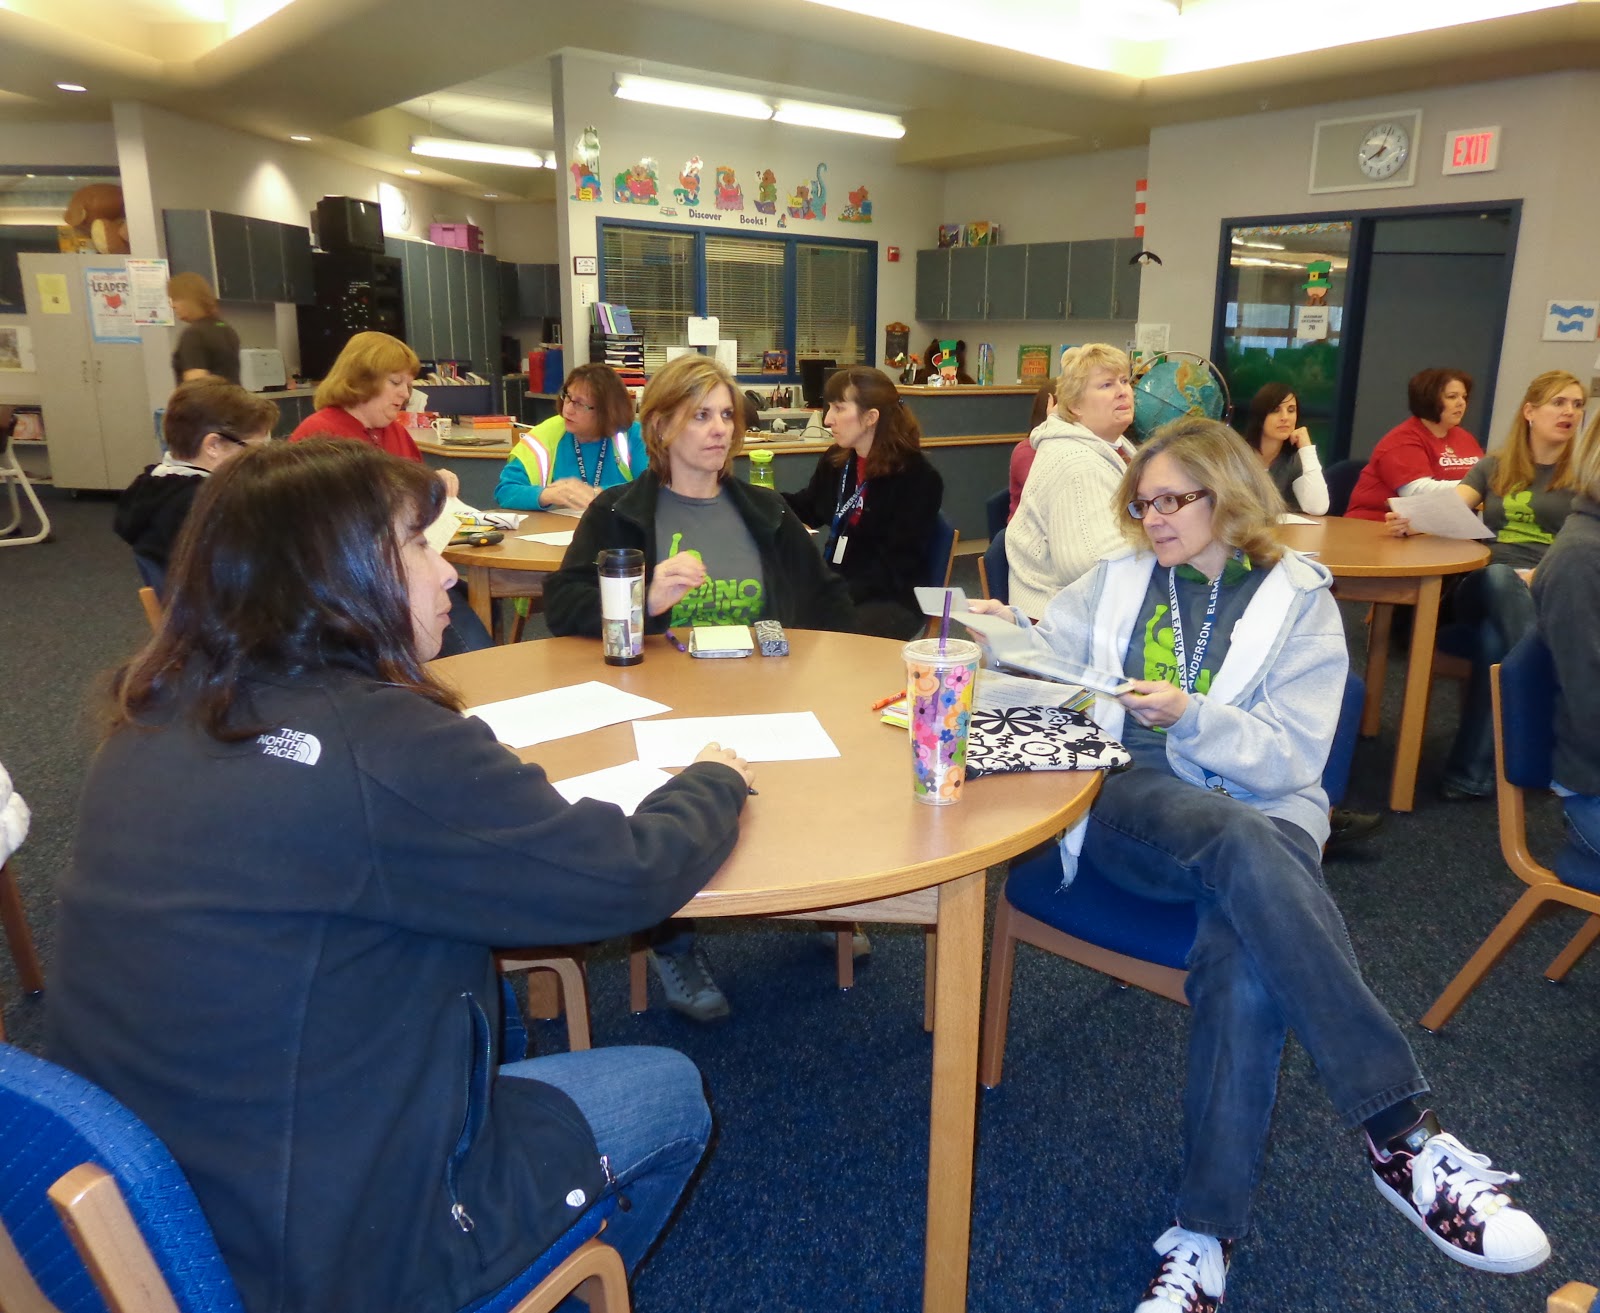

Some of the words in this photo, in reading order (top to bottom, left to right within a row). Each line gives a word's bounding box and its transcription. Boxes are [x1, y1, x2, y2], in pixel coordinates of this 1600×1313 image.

[1452, 132, 1493, 167] EXIT
[688, 208, 722, 221] Discover
[740, 214, 768, 226] Books!
[91, 280, 129, 293] LEADER
[1438, 456, 1479, 467] GLEASO
[1188, 622, 1212, 689] ANDERSON
[256, 734, 301, 750] NORTH
[281, 728, 306, 742] THE
[263, 745, 296, 760] FACE
